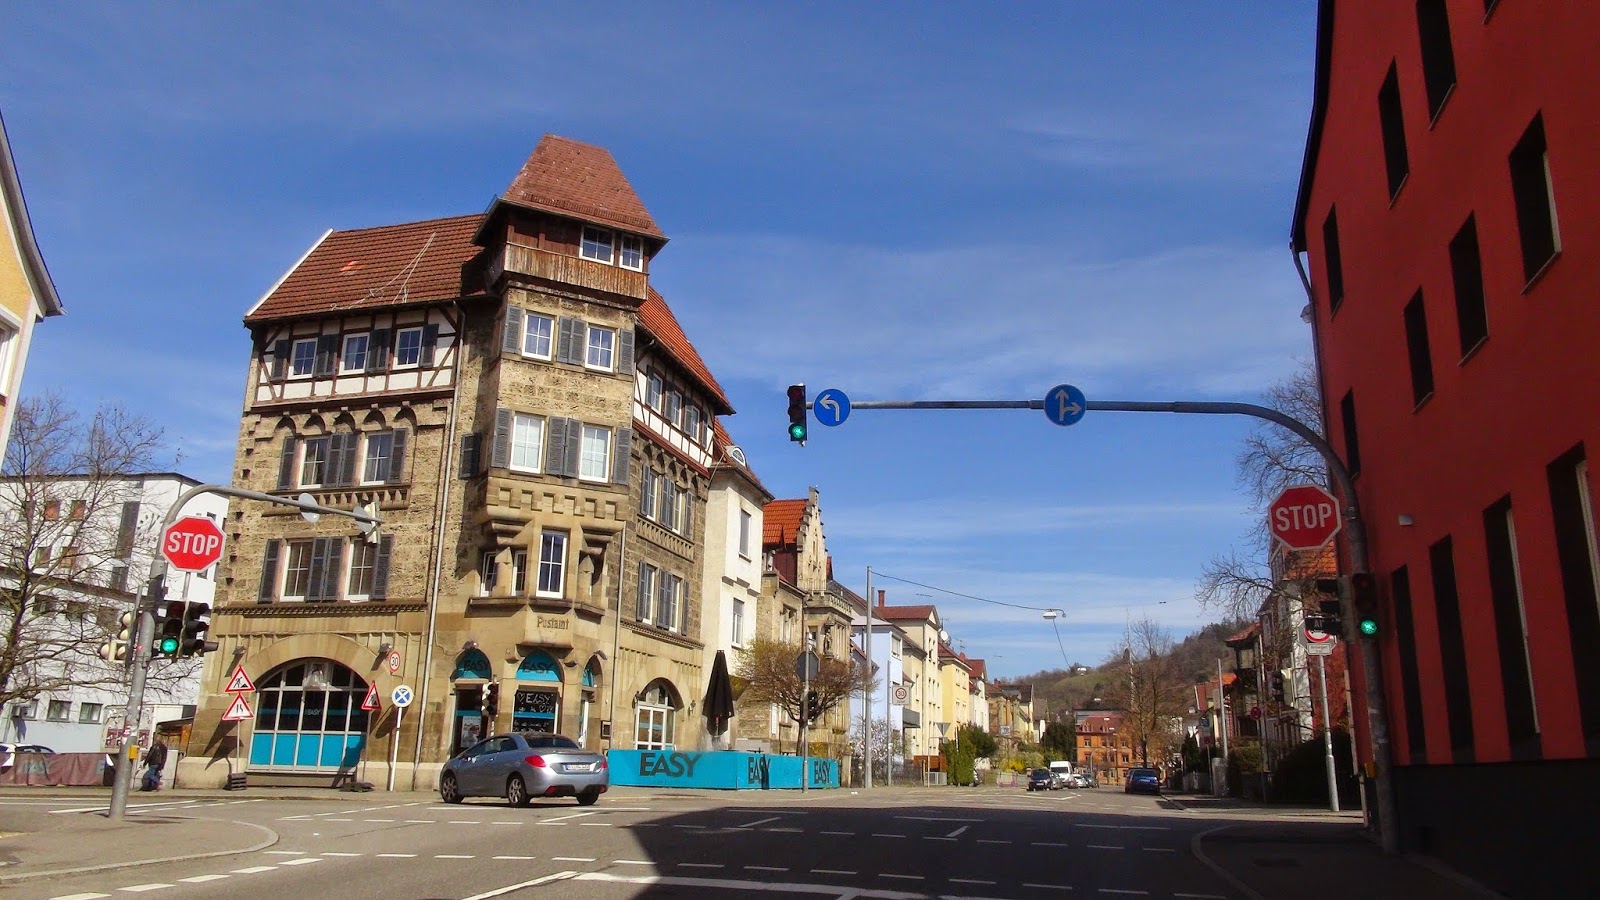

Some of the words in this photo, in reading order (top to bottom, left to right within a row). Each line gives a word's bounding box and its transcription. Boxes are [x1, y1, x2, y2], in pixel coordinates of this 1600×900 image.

[1276, 503, 1332, 532] STOP
[168, 531, 219, 556] STOP
[391, 656, 399, 667] 30
[464, 660, 489, 672] EASY
[523, 662, 554, 674] EASY
[526, 693, 551, 705] EASY
[639, 753, 703, 777] EASY
[748, 757, 771, 784] EASY
[814, 760, 832, 784] EASY
